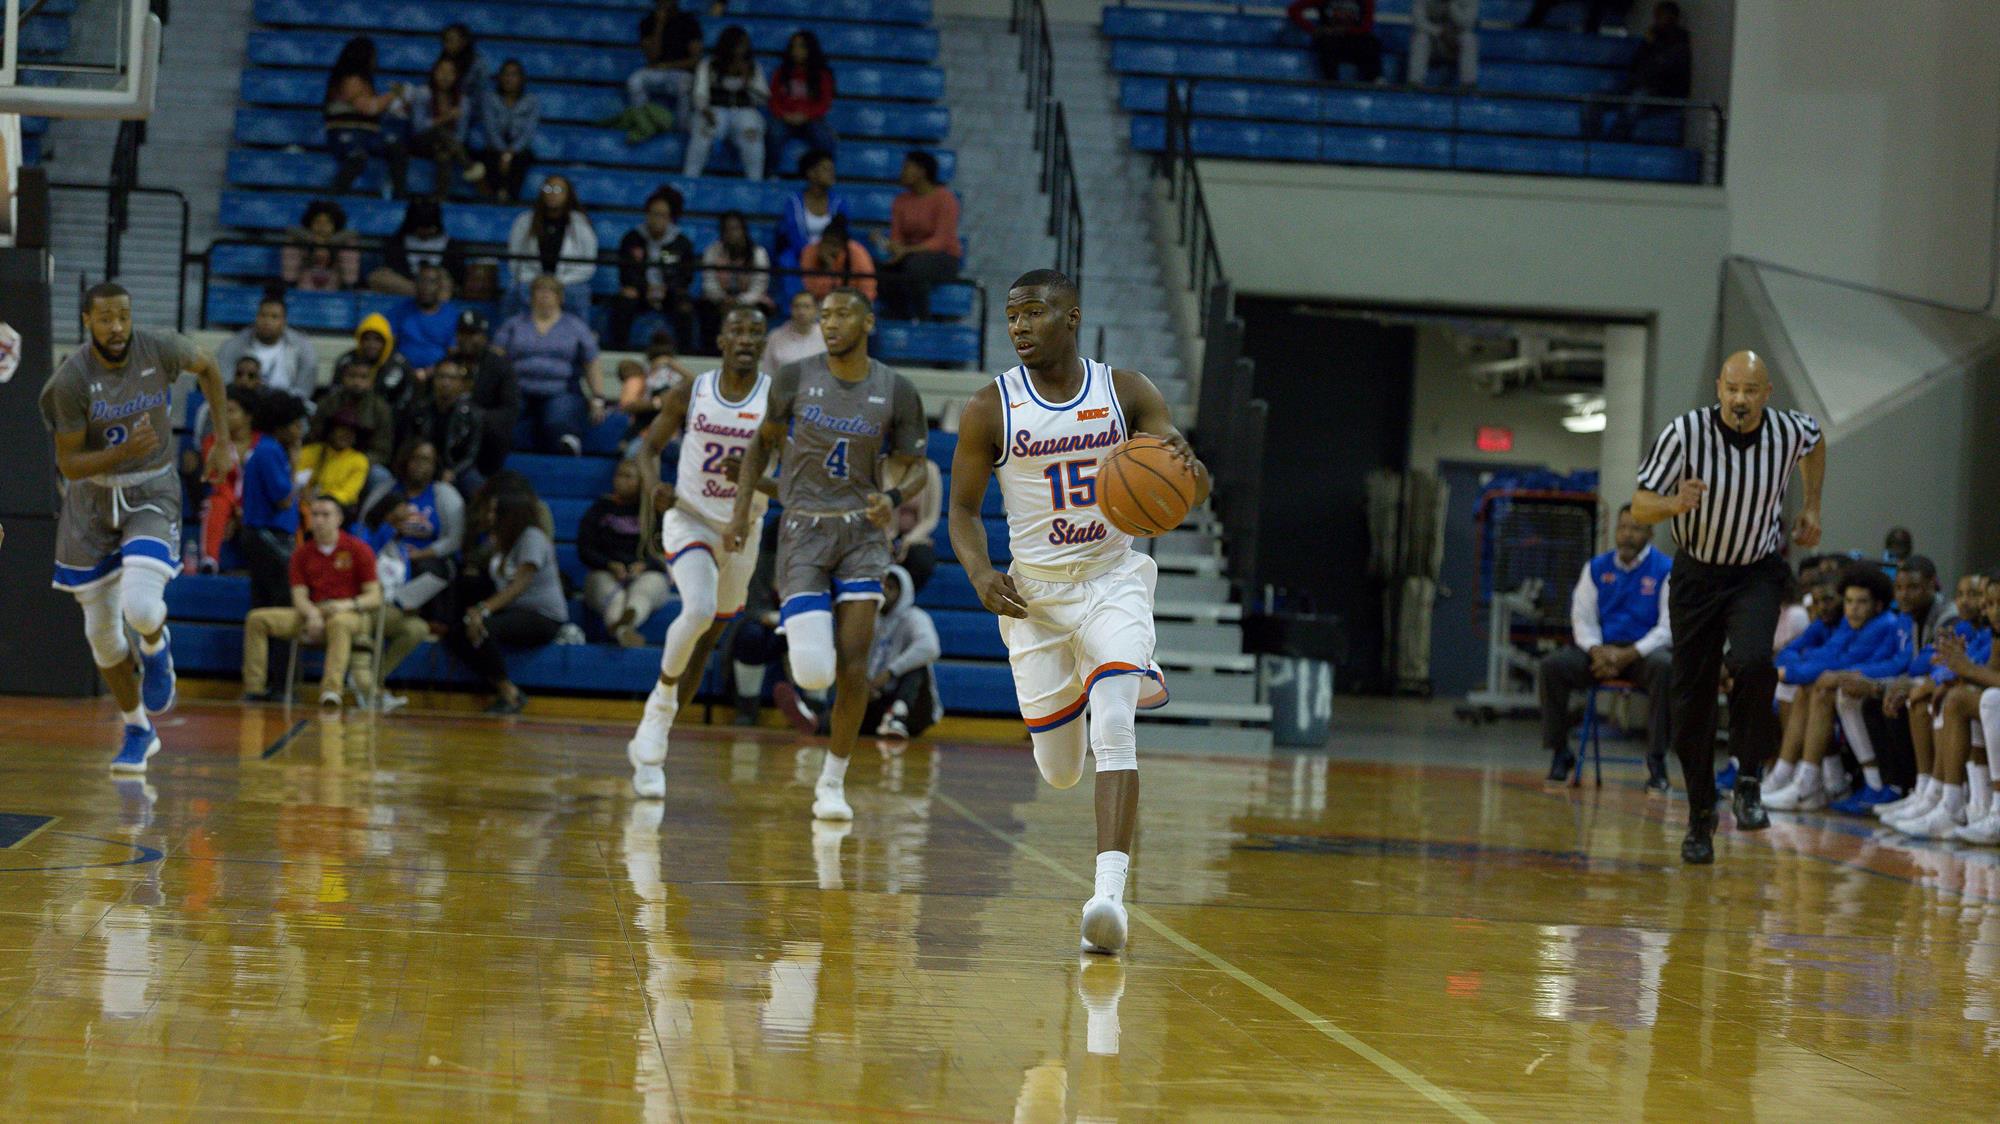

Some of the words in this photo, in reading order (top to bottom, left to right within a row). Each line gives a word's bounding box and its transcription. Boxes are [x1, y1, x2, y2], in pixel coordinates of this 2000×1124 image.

[694, 414, 756, 439] Savanna
[802, 404, 882, 437] Pirates
[1011, 419, 1122, 458] Savannah
[823, 437, 850, 480] 4
[1043, 457, 1099, 512] 15
[1048, 517, 1107, 546] State
